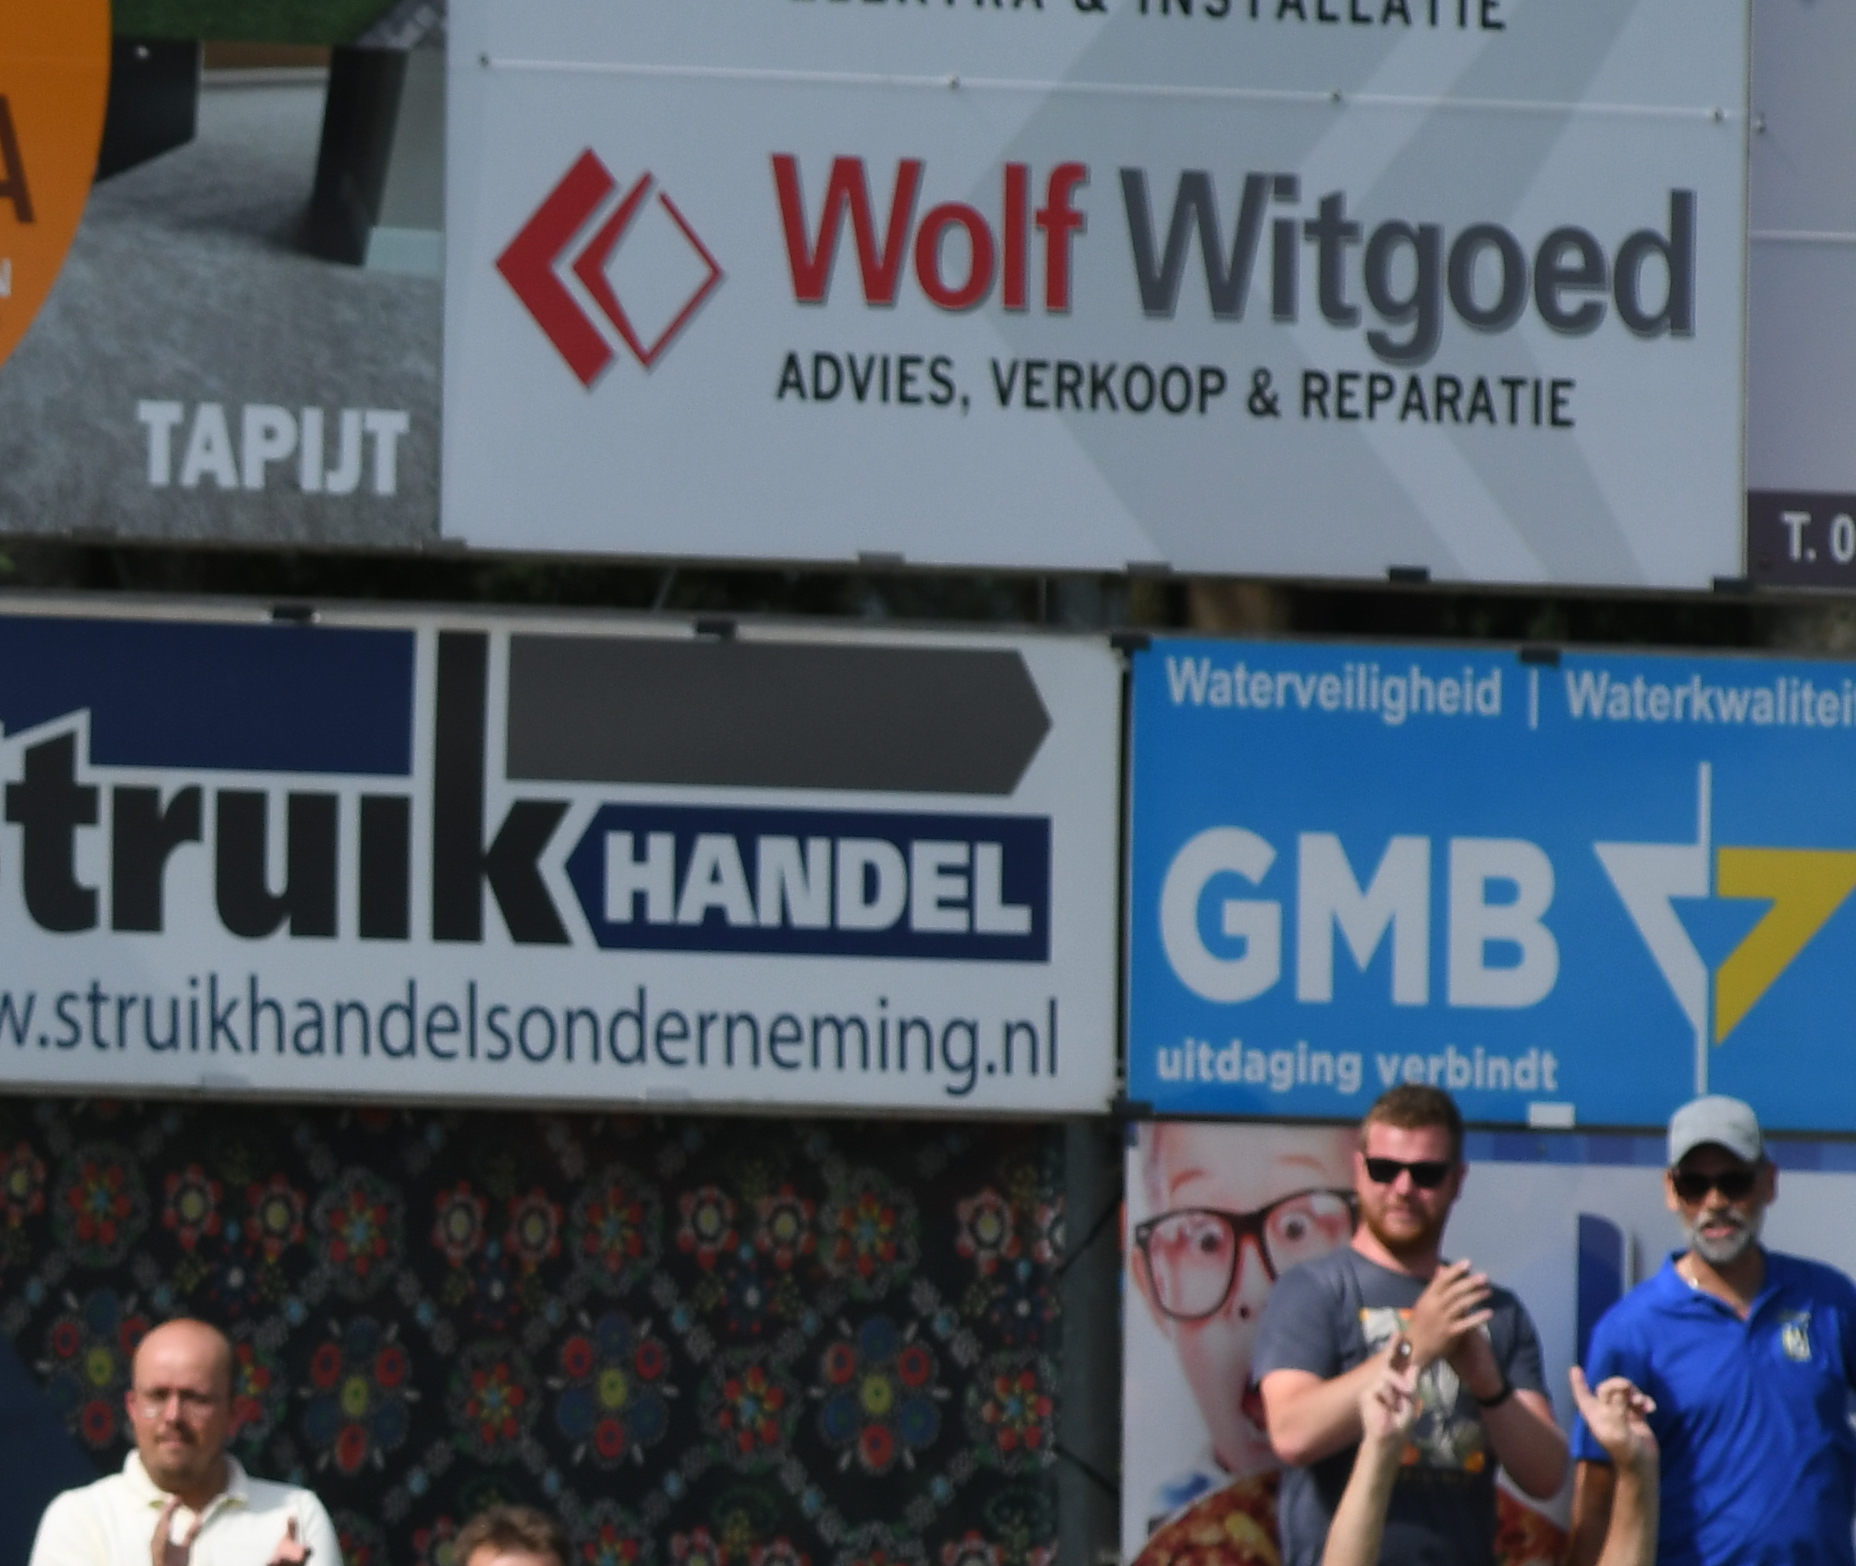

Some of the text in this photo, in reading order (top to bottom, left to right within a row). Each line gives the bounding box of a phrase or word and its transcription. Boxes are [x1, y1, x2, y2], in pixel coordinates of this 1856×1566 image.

[771, 153, 1695, 365] Wolf Witgoed
[778, 352, 1576, 428] ADVIES, VERKOOP & REPARATIE
[138, 401, 409, 496] TAPIJT
[1781, 511, 1817, 562] T.
[1166, 657, 1856, 727] Waterveiligheid Waterkwalitei
[604, 830, 1032, 934] HANDEL
[1160, 826, 1560, 1009] GMB
[1156, 1039, 1558, 1093] uitdaging verbindt
